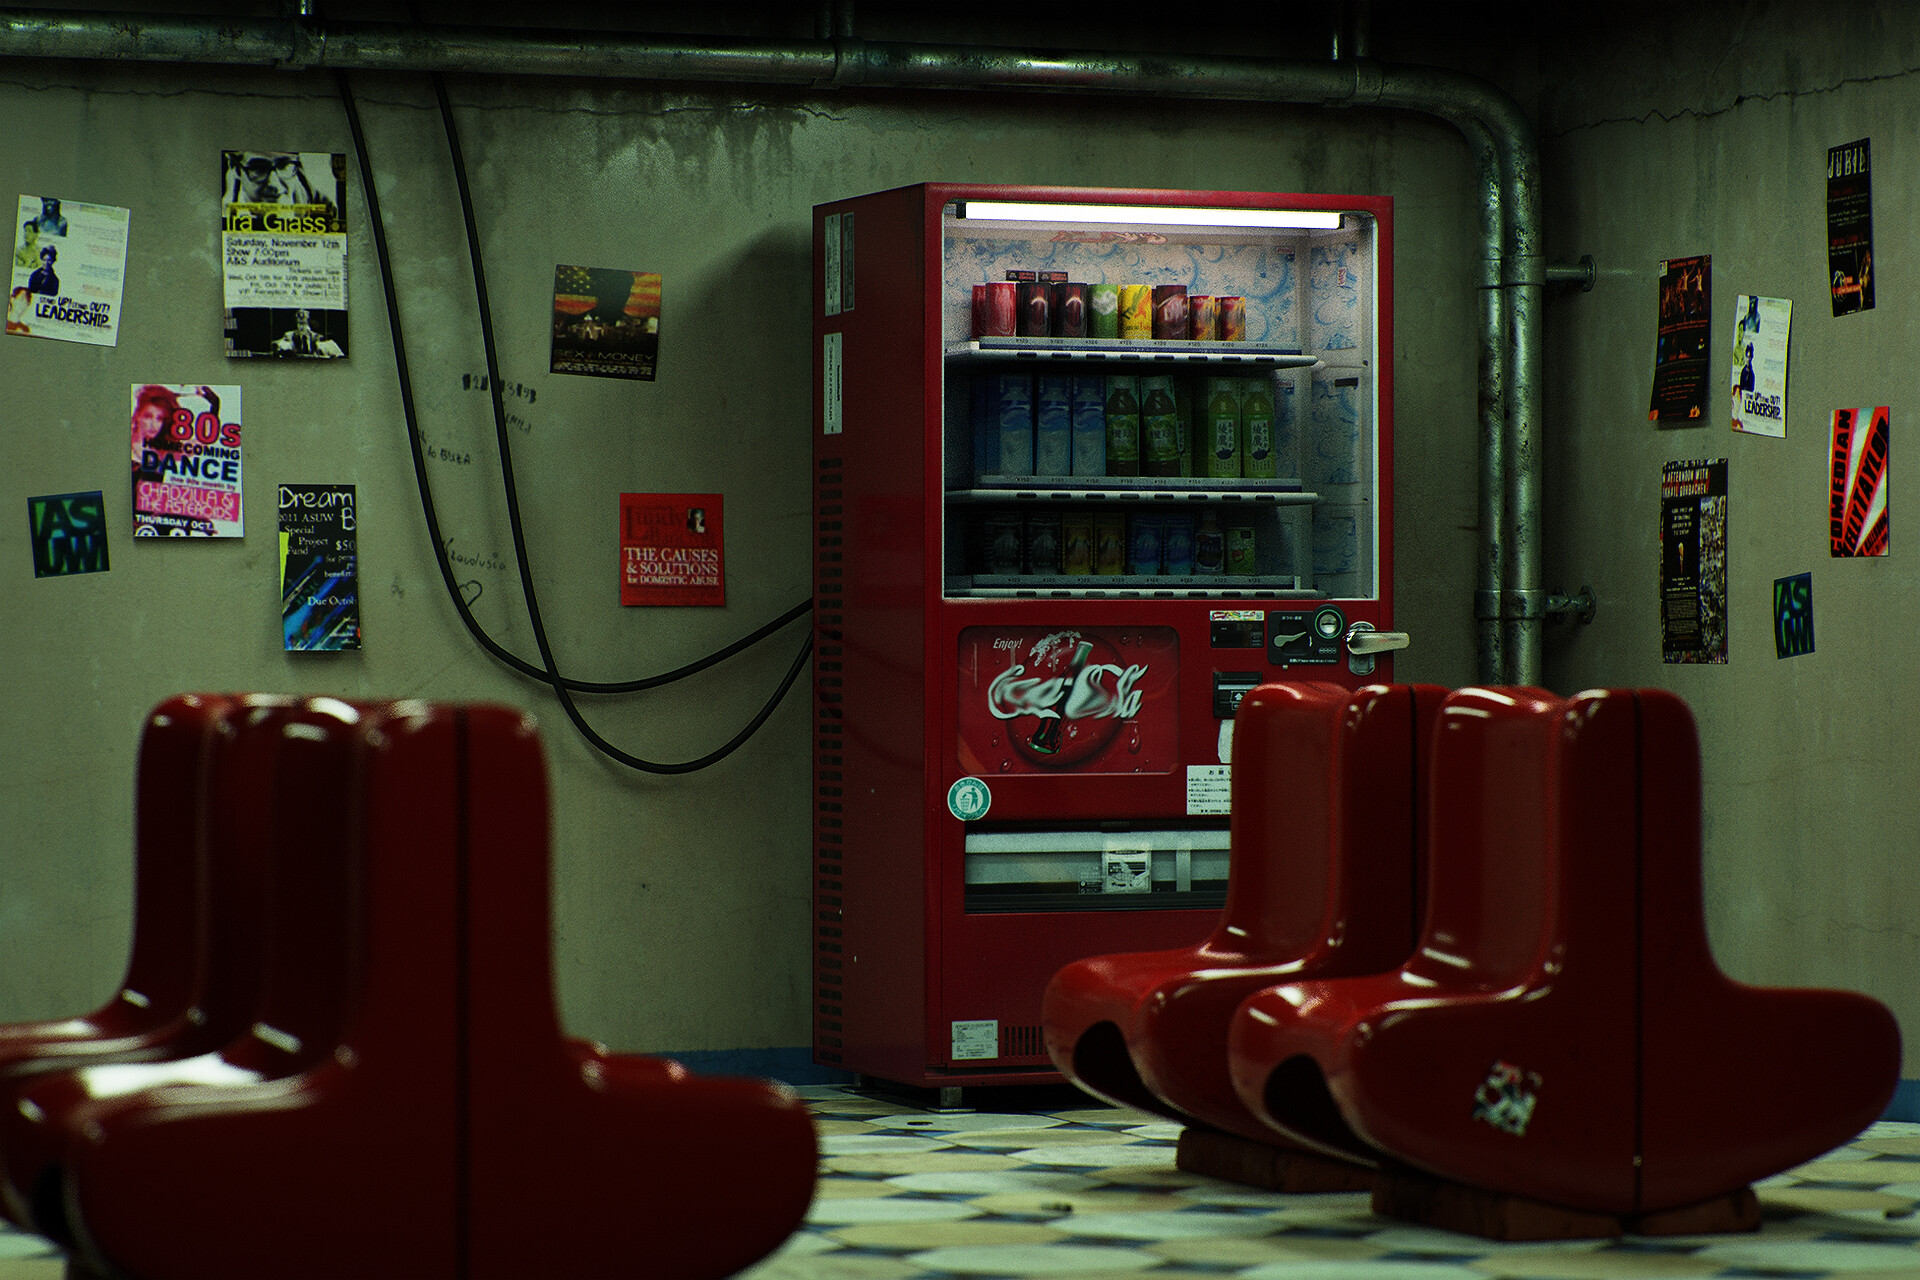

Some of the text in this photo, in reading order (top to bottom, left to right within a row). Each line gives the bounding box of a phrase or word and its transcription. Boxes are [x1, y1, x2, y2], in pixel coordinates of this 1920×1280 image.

[226, 208, 252, 232] Ira
[263, 211, 327, 233] Glass
[271, 238, 317, 248] November
[36, 303, 110, 328] LEADERSHIP
[598, 352, 654, 362] MONEY
[1744, 399, 1780, 419] LEADERSHIP
[170, 408, 241, 447] 80s
[142, 437, 240, 460] HMECOMING
[142, 449, 238, 482] DANCE
[279, 485, 353, 508] Dream
[135, 514, 188, 528] THURSDAY
[301, 513, 334, 522] ASUW
[285, 524, 314, 537] Special
[298, 536, 328, 548] Project
[624, 547, 719, 562] THE CAUSES
[626, 562, 718, 576] & SOLUTIONS
[640, 575, 688, 585] DOMESTIC
[690, 577, 719, 586] ABUSE
[307, 596, 327, 606] Due
[993, 638, 1023, 649] Enjoy!
